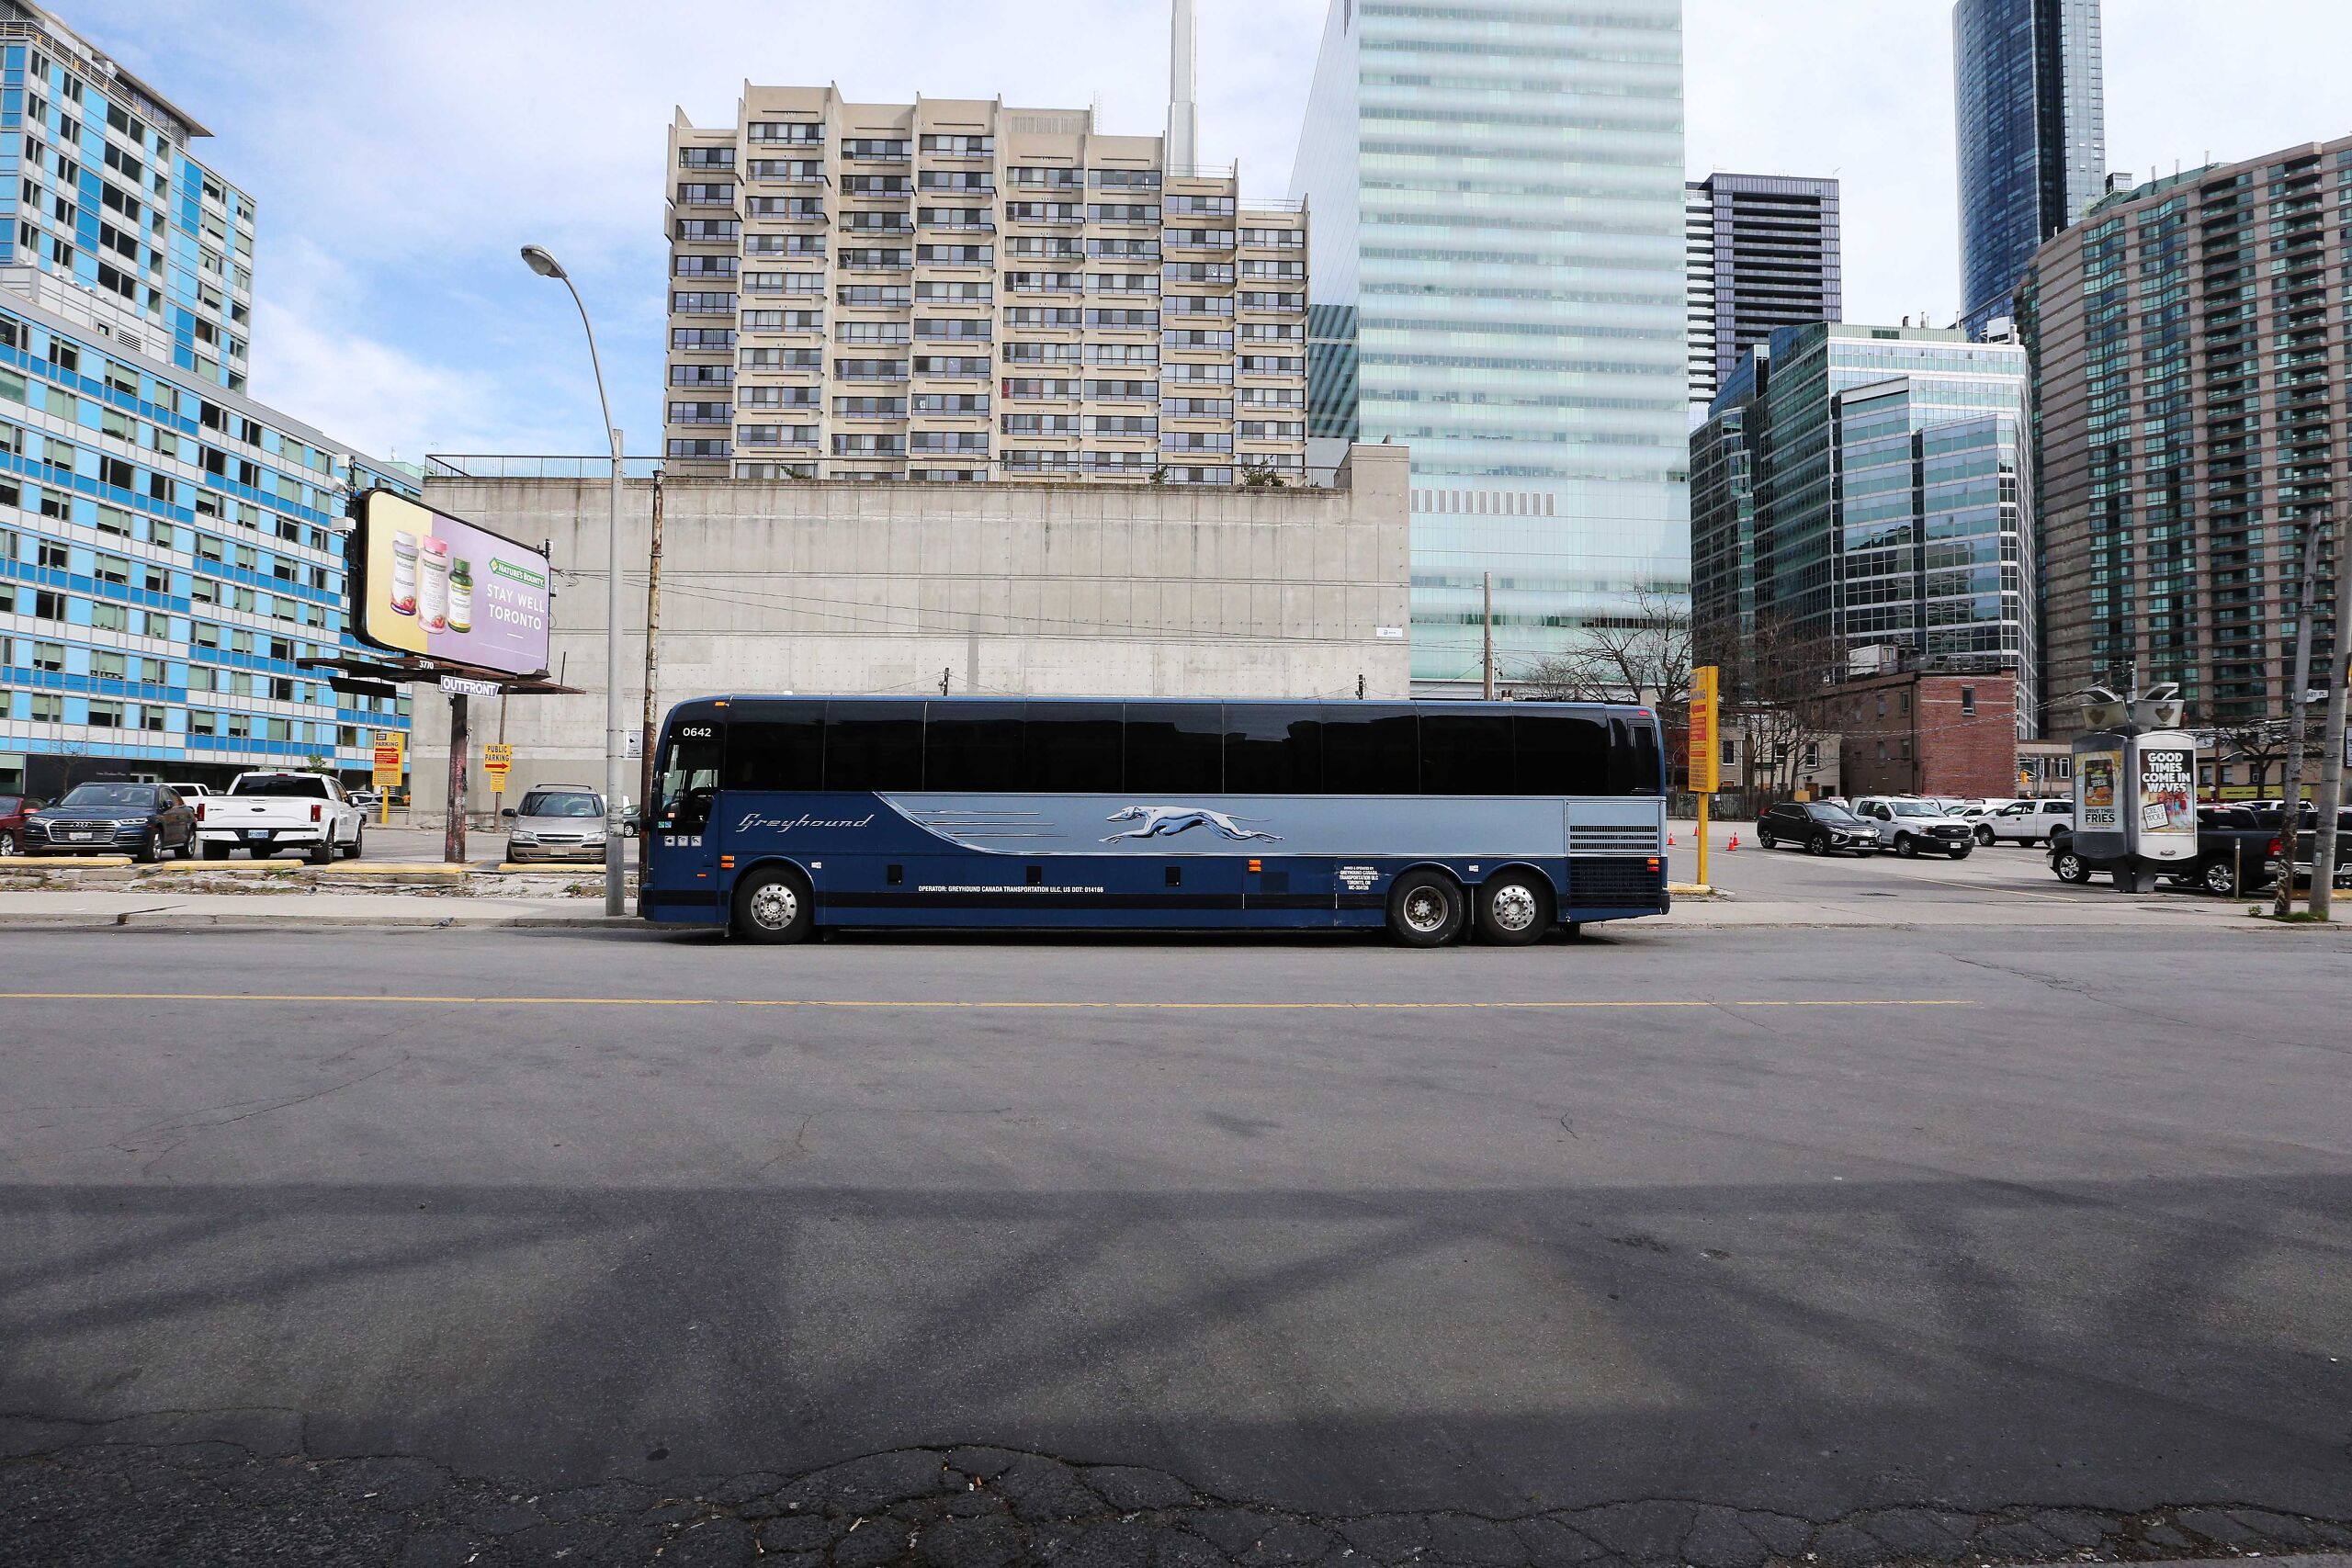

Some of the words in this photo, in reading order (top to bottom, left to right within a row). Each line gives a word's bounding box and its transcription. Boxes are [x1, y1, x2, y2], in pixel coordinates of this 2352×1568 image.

[487, 583, 513, 604] STAY
[517, 592, 545, 614] WELL
[489, 604, 542, 631] TORONTO
[419, 660, 435, 670] 3770
[443, 678, 496, 696] OUTFRONT
[683, 728, 712, 737] 0642
[487, 745, 507, 753] PUBLIC
[2147, 752, 2183, 762] GOOD
[2149, 762, 2183, 773] TIMES
[2142, 773, 2176, 783] COME
[2177, 773, 2191, 783] IN
[2146, 783, 2187, 793] WAVES
[736, 813, 875, 833] Greyhound
[2086, 814, 2116, 823] FRIES
